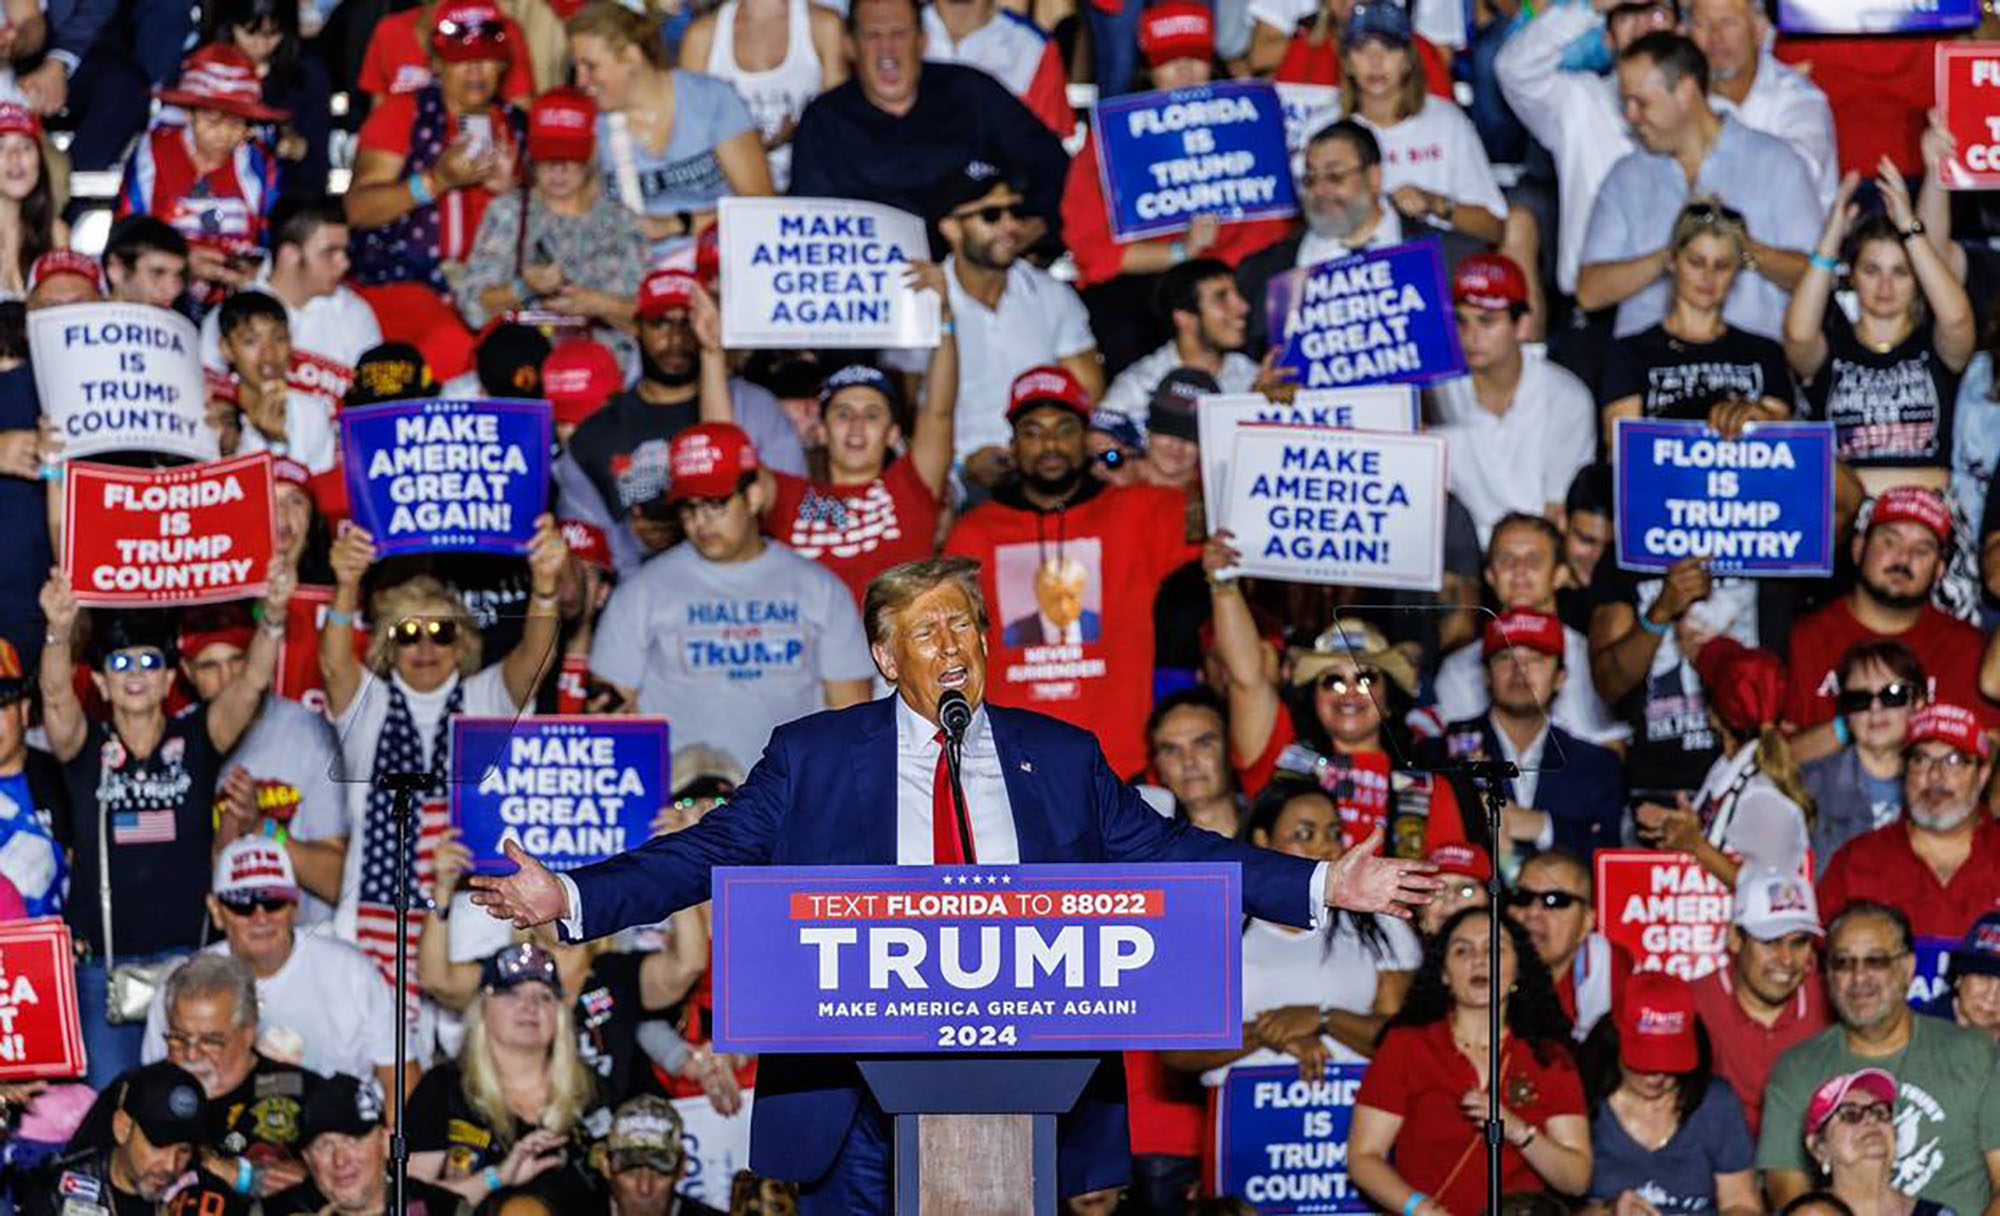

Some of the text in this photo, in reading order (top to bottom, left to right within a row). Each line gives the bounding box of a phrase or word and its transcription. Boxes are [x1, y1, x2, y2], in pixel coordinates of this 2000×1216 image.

[1128, 96, 1260, 138] FLORIDA
[1182, 127, 1215, 154] IS
[1148, 150, 1255, 187] TRUMP
[1136, 174, 1277, 219] COUNTRY
[780, 215, 876, 238] MAKE
[752, 243, 907, 265] AMERICA
[773, 270, 888, 294] GREAT
[1305, 260, 1393, 303] MAKE
[771, 300, 890, 324] AGAIN!
[1283, 284, 1426, 339] AMERICA
[65, 323, 186, 354] FLORIDA
[1301, 316, 1409, 360] GREAT
[120, 353, 146, 372] IS
[1307, 342, 1421, 387] AGAIN!
[82, 381, 181, 404] TRUMP
[67, 410, 197, 437] COUNTRY
[396, 414, 499, 445] MAKE
[368, 444, 528, 480] AMERICA
[1282, 446, 1380, 475] MAKE
[1653, 440, 1795, 469] FLORIDA
[104, 476, 244, 511] FLORIDA
[390, 472, 509, 503] GREAT
[1249, 475, 1410, 508] AMERICA
[1708, 471, 1740, 497] IS
[160, 512, 191, 537] IS
[389, 502, 511, 534] AGAIN!
[1268, 506, 1388, 535] GREAT
[1666, 499, 1780, 527] TRUMP
[116, 534, 233, 564] TRUMP
[1263, 536, 1389, 564] AGAIN!
[1645, 530, 1801, 559] COUNTRY
[92, 559, 253, 590] COUNTRY
[687, 601, 798, 623] HIALEAH
[687, 640, 803, 665] TRUMP
[511, 737, 615, 766] MAKE
[478, 765, 645, 796] AMERICA
[500, 796, 624, 825] GREAT
[495, 826, 625, 855] AGAIN!
[809, 893, 1147, 918] TEXT FLORIDA TO 88022
[1621, 895, 1734, 924] AMERI
[1641, 924, 1728, 954] GRE
[800, 926, 1155, 990] TRUMP
[818, 1000, 1137, 1017] MAKE AMERICA GREAT AGAIN!
[938, 1026, 1018, 1047] 2024
[1255, 1080, 1361, 1109] FLORID
[1304, 1111, 1333, 1137] IS
[1266, 1142, 1348, 1170] TRUM
[1246, 1173, 1352, 1202] COUNT
